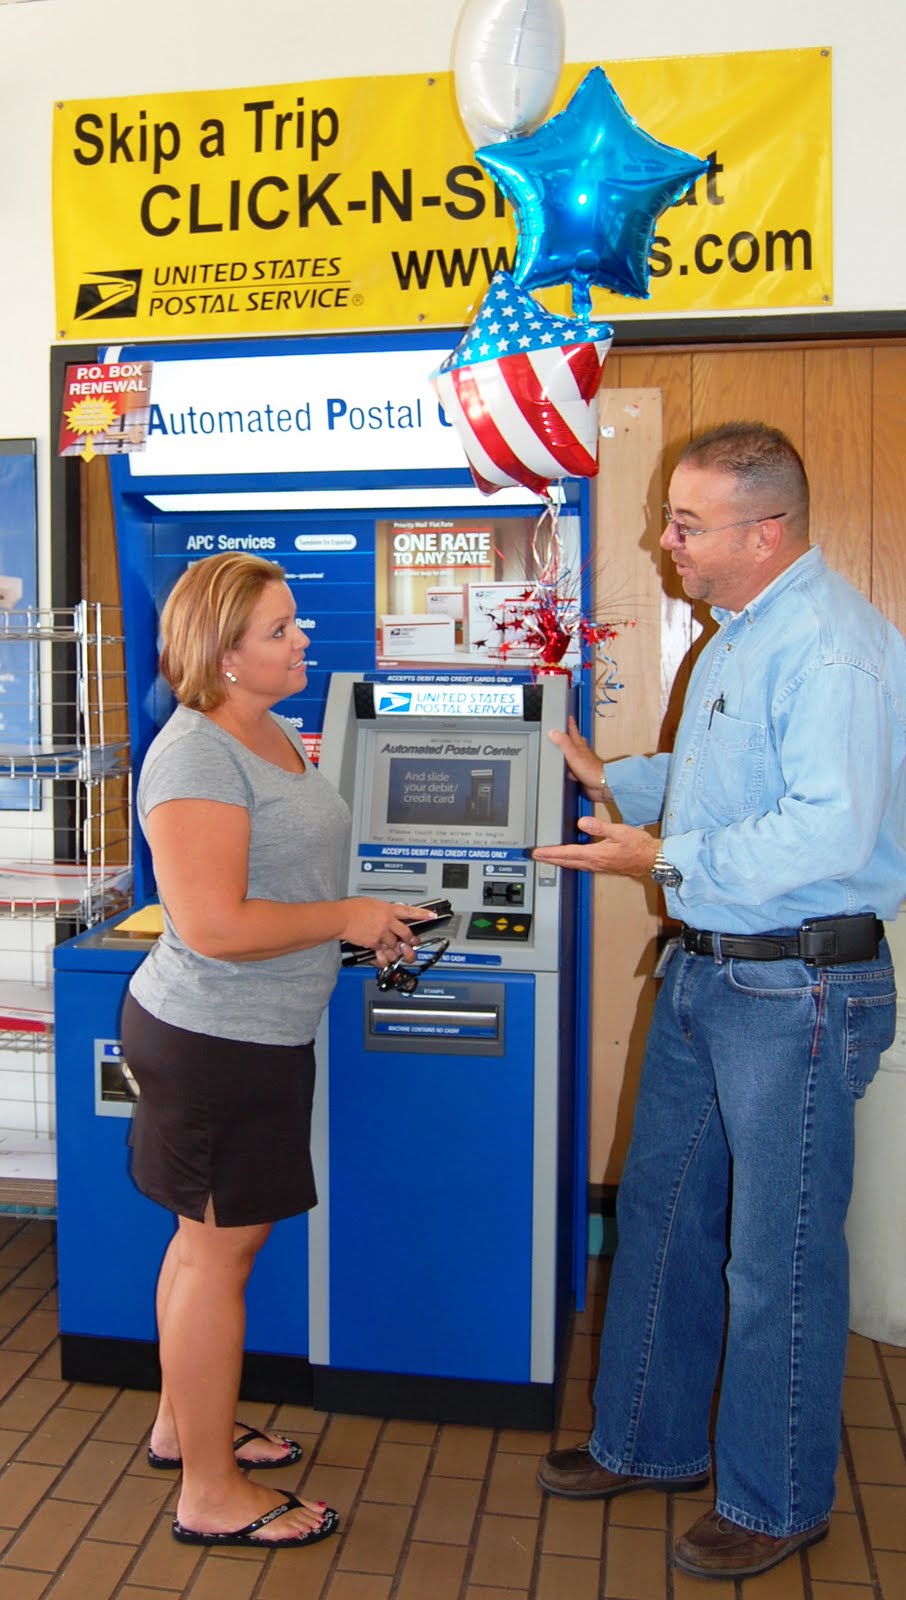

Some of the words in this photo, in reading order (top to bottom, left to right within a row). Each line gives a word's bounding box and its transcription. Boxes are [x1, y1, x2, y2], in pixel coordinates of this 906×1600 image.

[73, 113, 181, 174] Skip
[199, 119, 225, 158] a
[244, 97, 339, 161] Trip
[140, 164, 508, 237] CLICK-N-S
[153, 261, 248, 286] UNITED
[252, 257, 342, 281] STATES
[149, 293, 240, 317] POSTAL
[76, 367, 104, 380] P.O.
[109, 364, 144, 378] BOX
[69, 380, 147, 395] RENEWAL
[148, 402, 311, 435] Automated
[327, 398, 422, 431] Postal
[187, 535, 215, 550] APC
[218, 535, 276, 550] Services
[393, 533, 438, 552] ONE
[441, 532, 491, 551] RATE
[393, 552, 414, 565] TO
[415, 551, 444, 565] ANY
[446, 550, 490, 564] STATE.
[295, 618, 316, 629] Rate
[387, 675, 415, 683] ACCEPTS
[417, 675, 435, 683] DEBIT
[450, 676, 472, 684] CREDIT
[474, 676, 495, 684] CARDS
[496, 676, 513, 684] ONLY
[416, 692, 467, 703] UNITED
[469, 693, 516, 704] STATES
[414, 703, 464, 714] POSTAL
[467, 704, 521, 715] SERVICE
[381, 743, 442, 755] Automated
[445, 744, 480, 756] Postal
[483, 745, 523, 757] Center
[404, 771, 426, 782] And
[427, 772, 450, 782] slide
[404, 784, 426, 794] your
[428, 783, 459, 793] debit/
[403, 794, 431, 804] credit
[433, 794, 455, 804] card
[381, 847, 410, 856] ACCEPTS
[411, 848, 430, 856] DEBIT
[430, 849, 444, 857] AND
[445, 849, 467, 858] CREDIT
[468, 850, 491, 858] CARDS
[491, 851, 508, 859] ONLY
